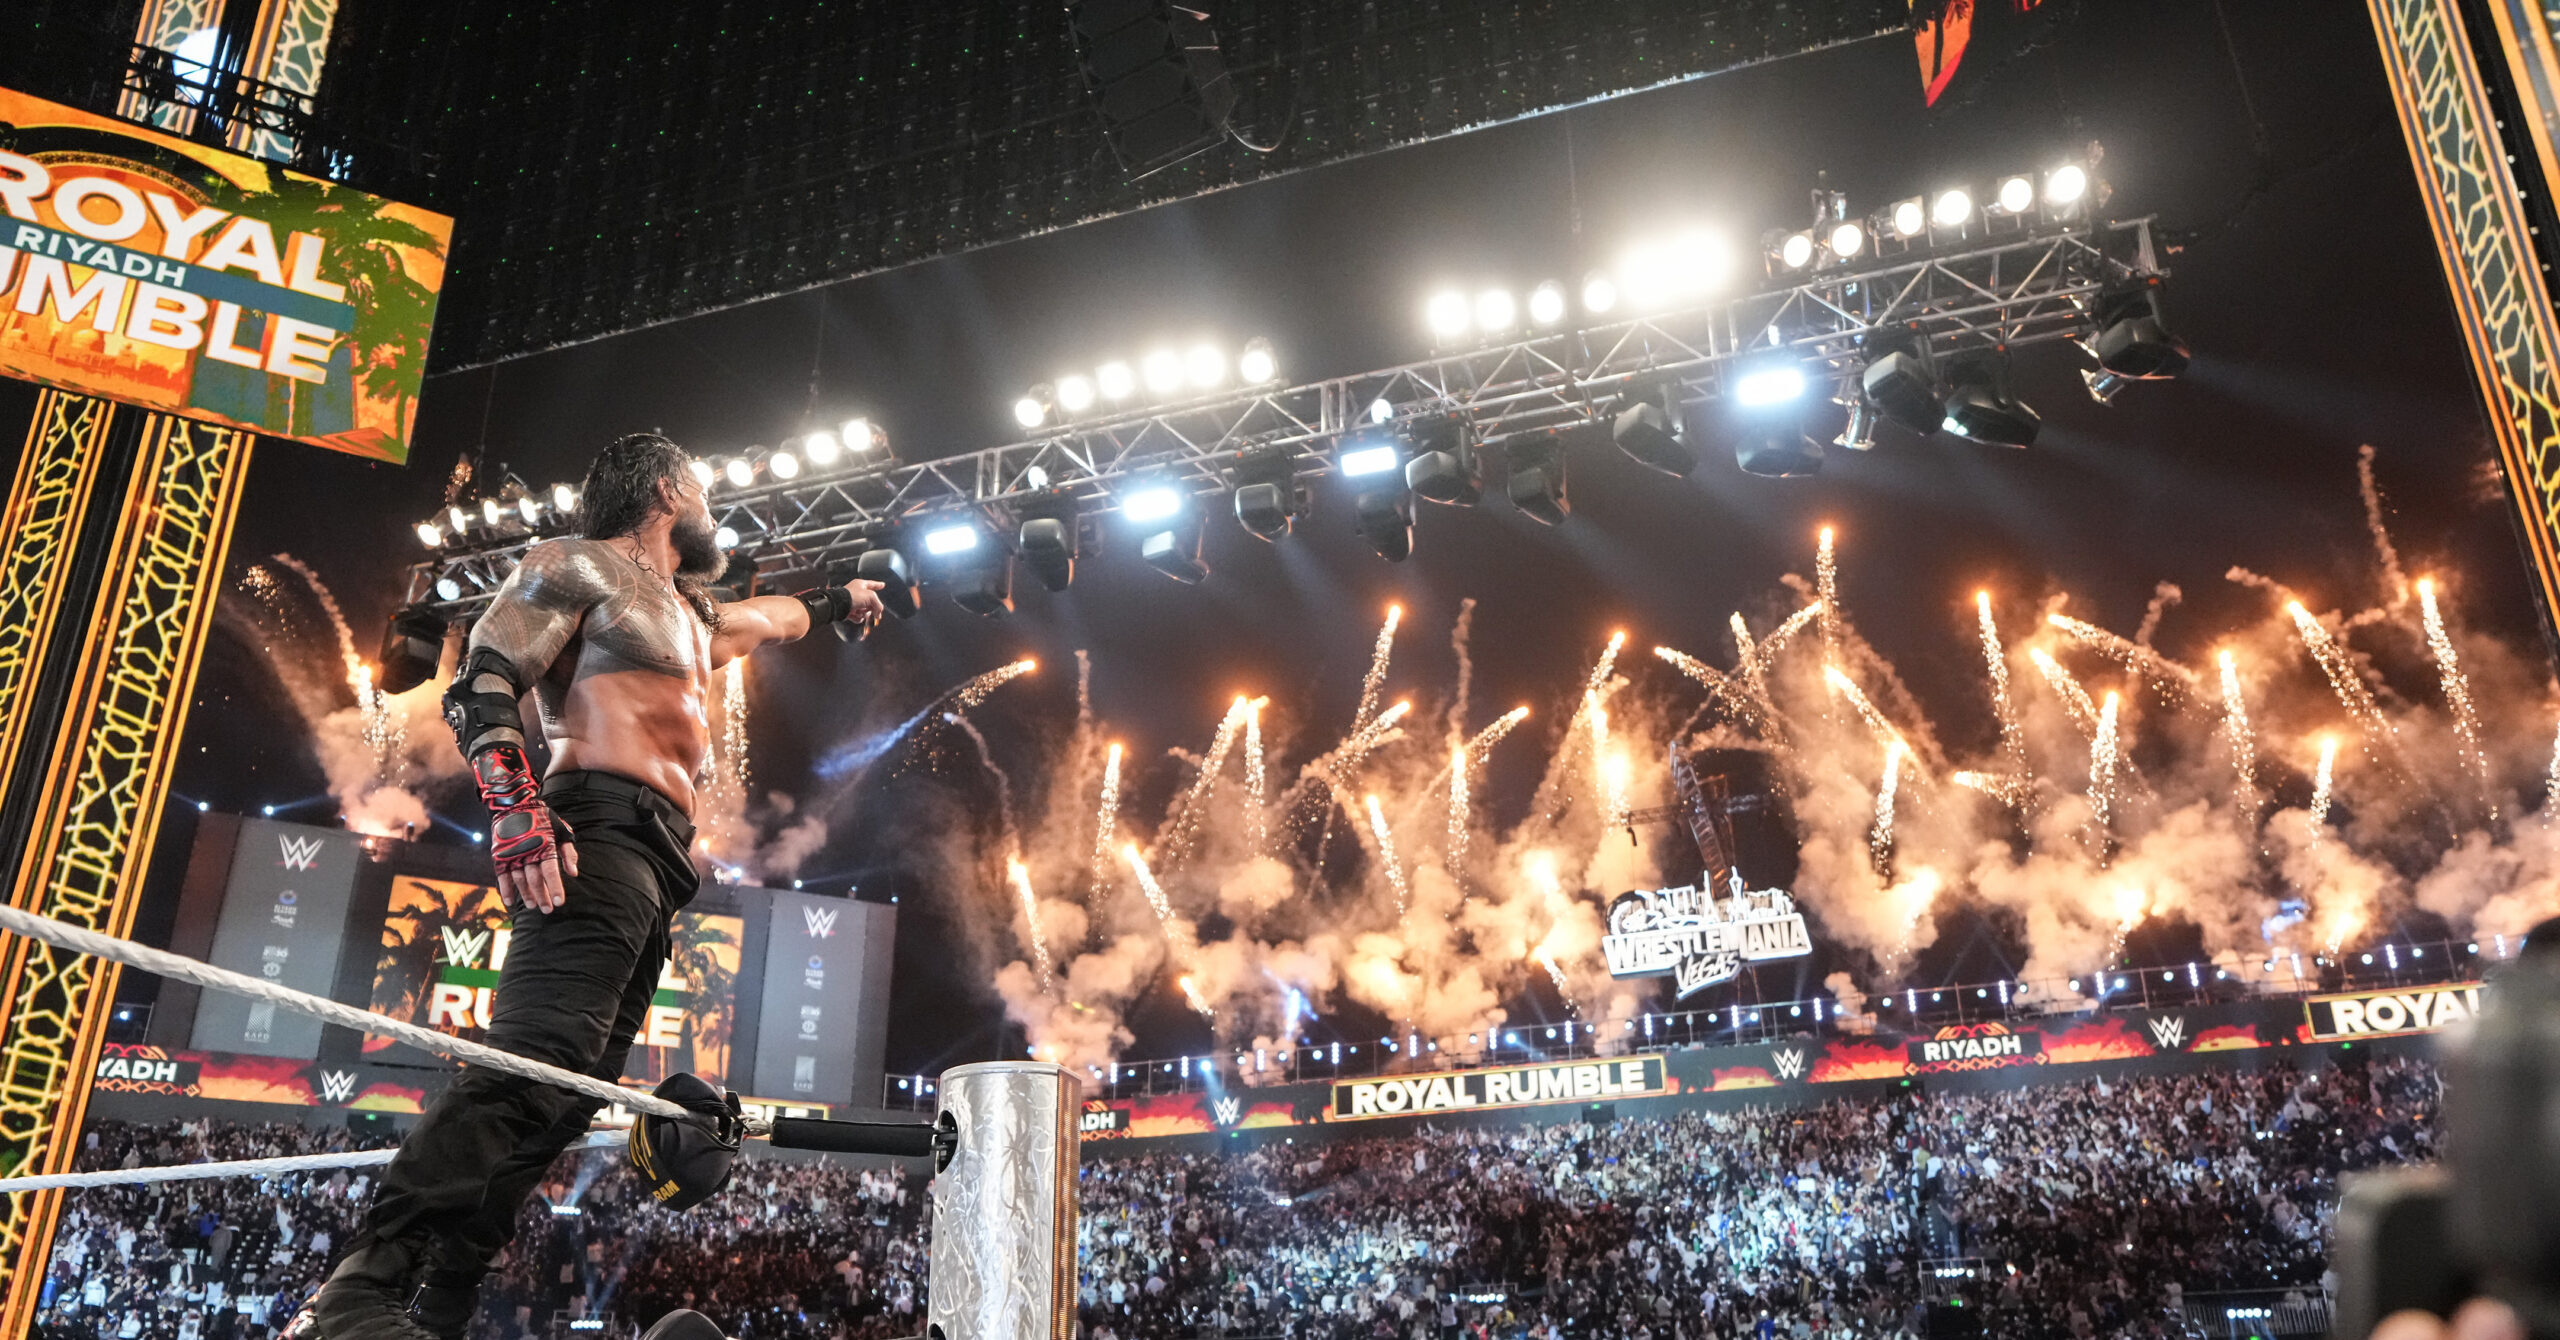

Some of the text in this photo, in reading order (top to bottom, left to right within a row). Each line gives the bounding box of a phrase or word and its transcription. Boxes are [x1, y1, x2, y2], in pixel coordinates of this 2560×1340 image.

[13, 224, 186, 288] RIYADH
[0, 243, 336, 385] MBLE
[1676, 952, 1741, 990] VEGAS
[1923, 1035, 2021, 1061] RIYADH
[1352, 1061, 1645, 1115] ROYAL RUMBLE
